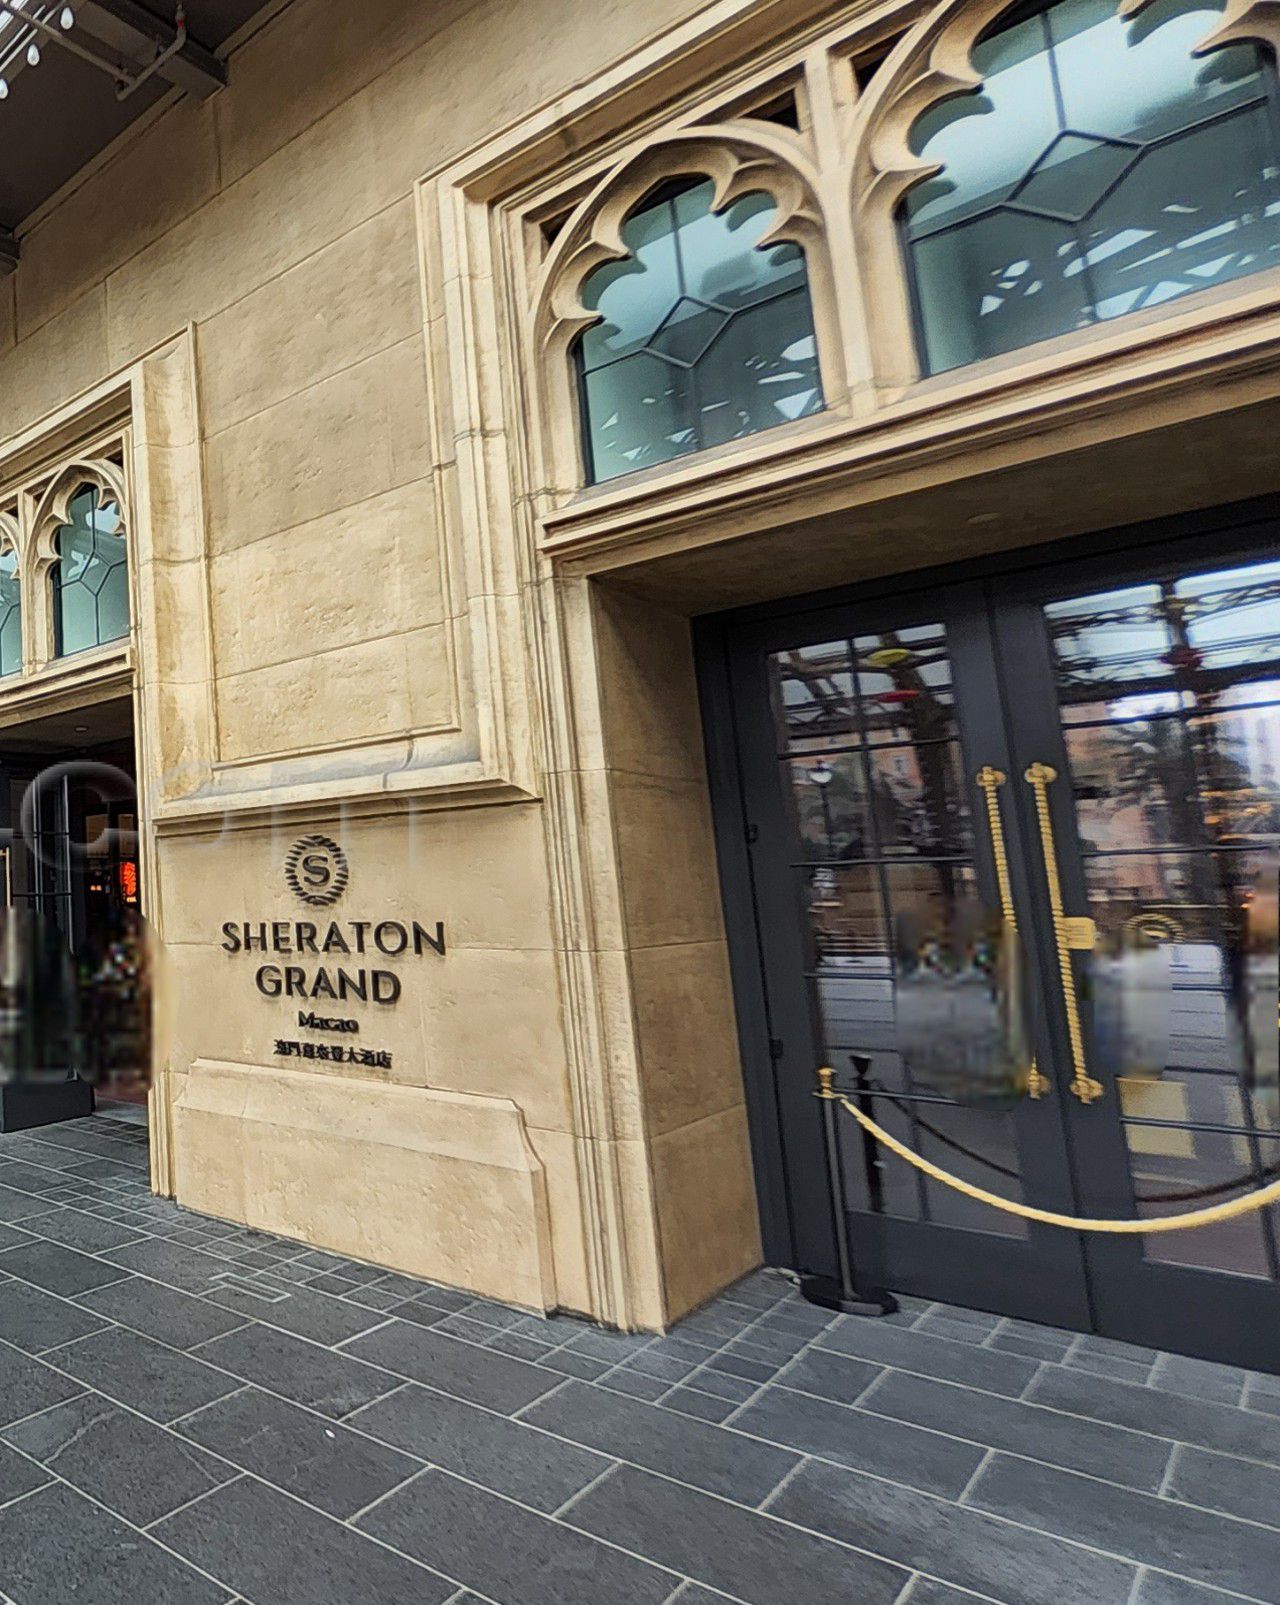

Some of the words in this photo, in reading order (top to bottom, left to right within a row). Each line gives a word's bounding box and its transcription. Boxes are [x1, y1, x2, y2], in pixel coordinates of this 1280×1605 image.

[221, 920, 446, 957] SHERATON
[255, 965, 402, 1005] GRAND
[298, 1010, 360, 1034] Macao
